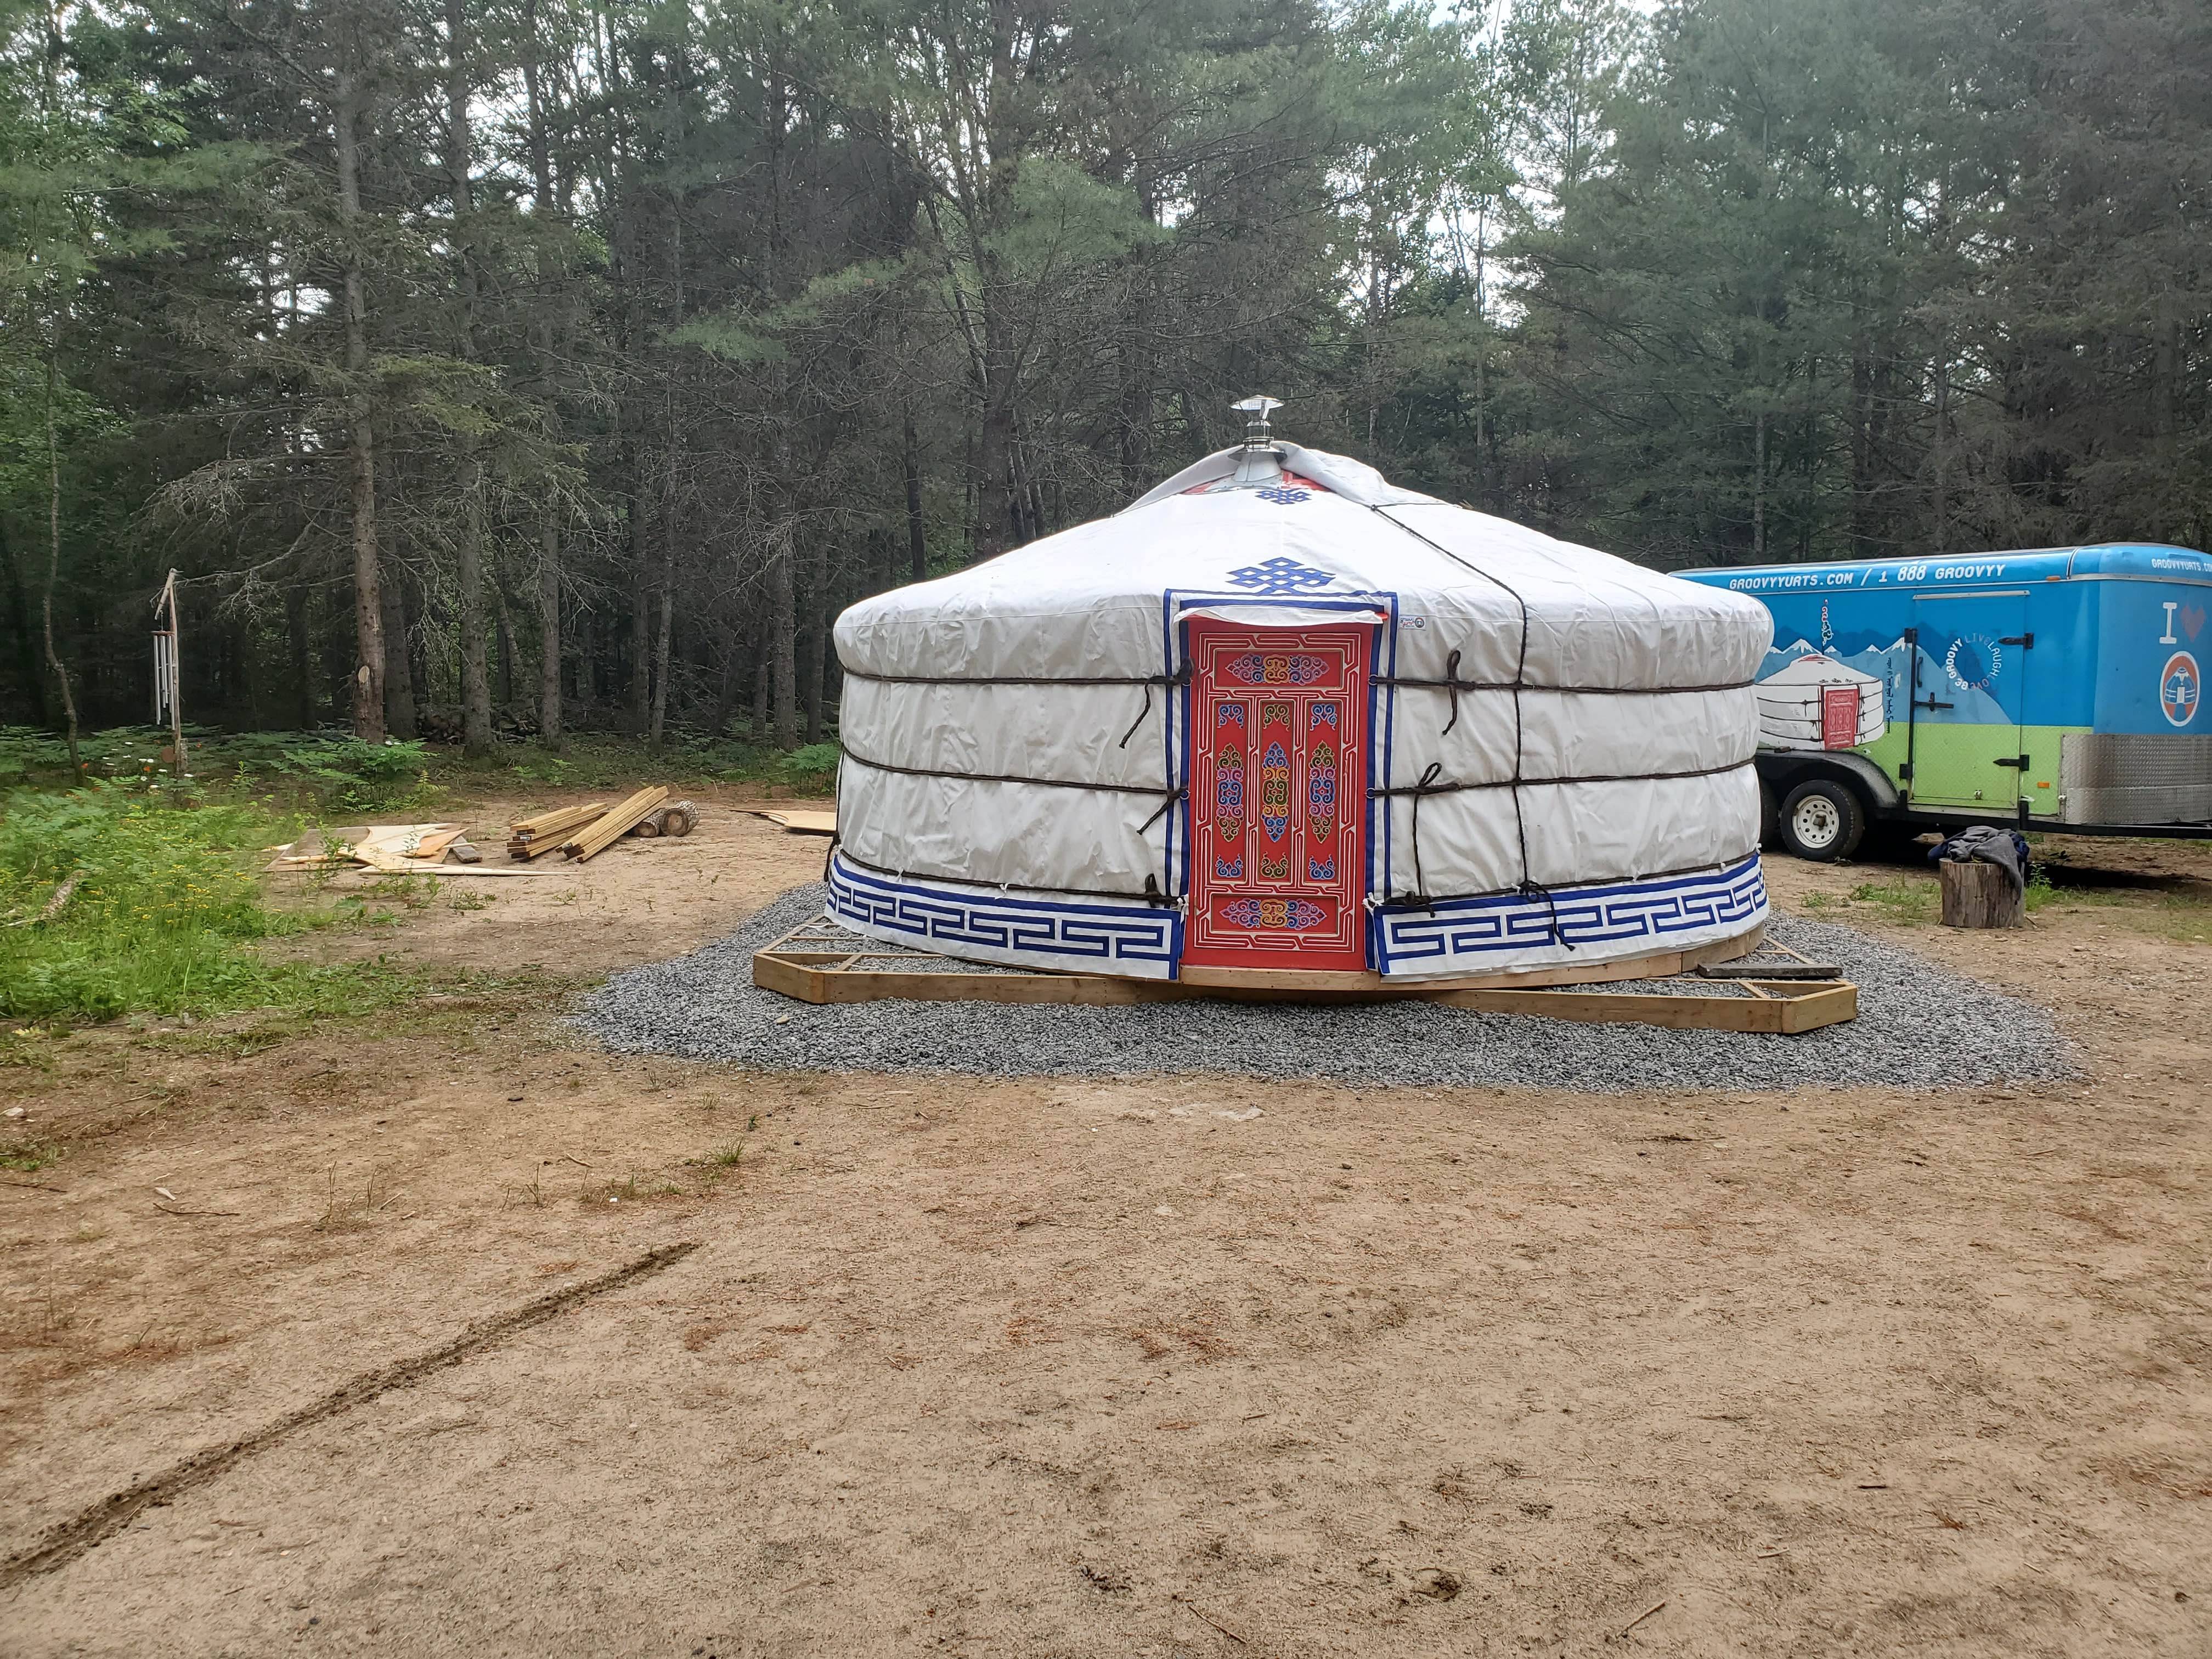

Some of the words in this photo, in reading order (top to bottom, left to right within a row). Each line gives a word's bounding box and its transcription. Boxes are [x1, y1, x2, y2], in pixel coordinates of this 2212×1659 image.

[1729, 573, 1854, 590] GROOVYYURTS.COM
[1878, 571, 1887, 583] 1
[1897, 565, 1927, 582] 888
[1935, 564, 2006, 580] GROOVYY
[2159, 602, 2177, 644] I
[1945, 637, 1963, 679] GROOVY
[1987, 641, 2002, 676] LAUGH
